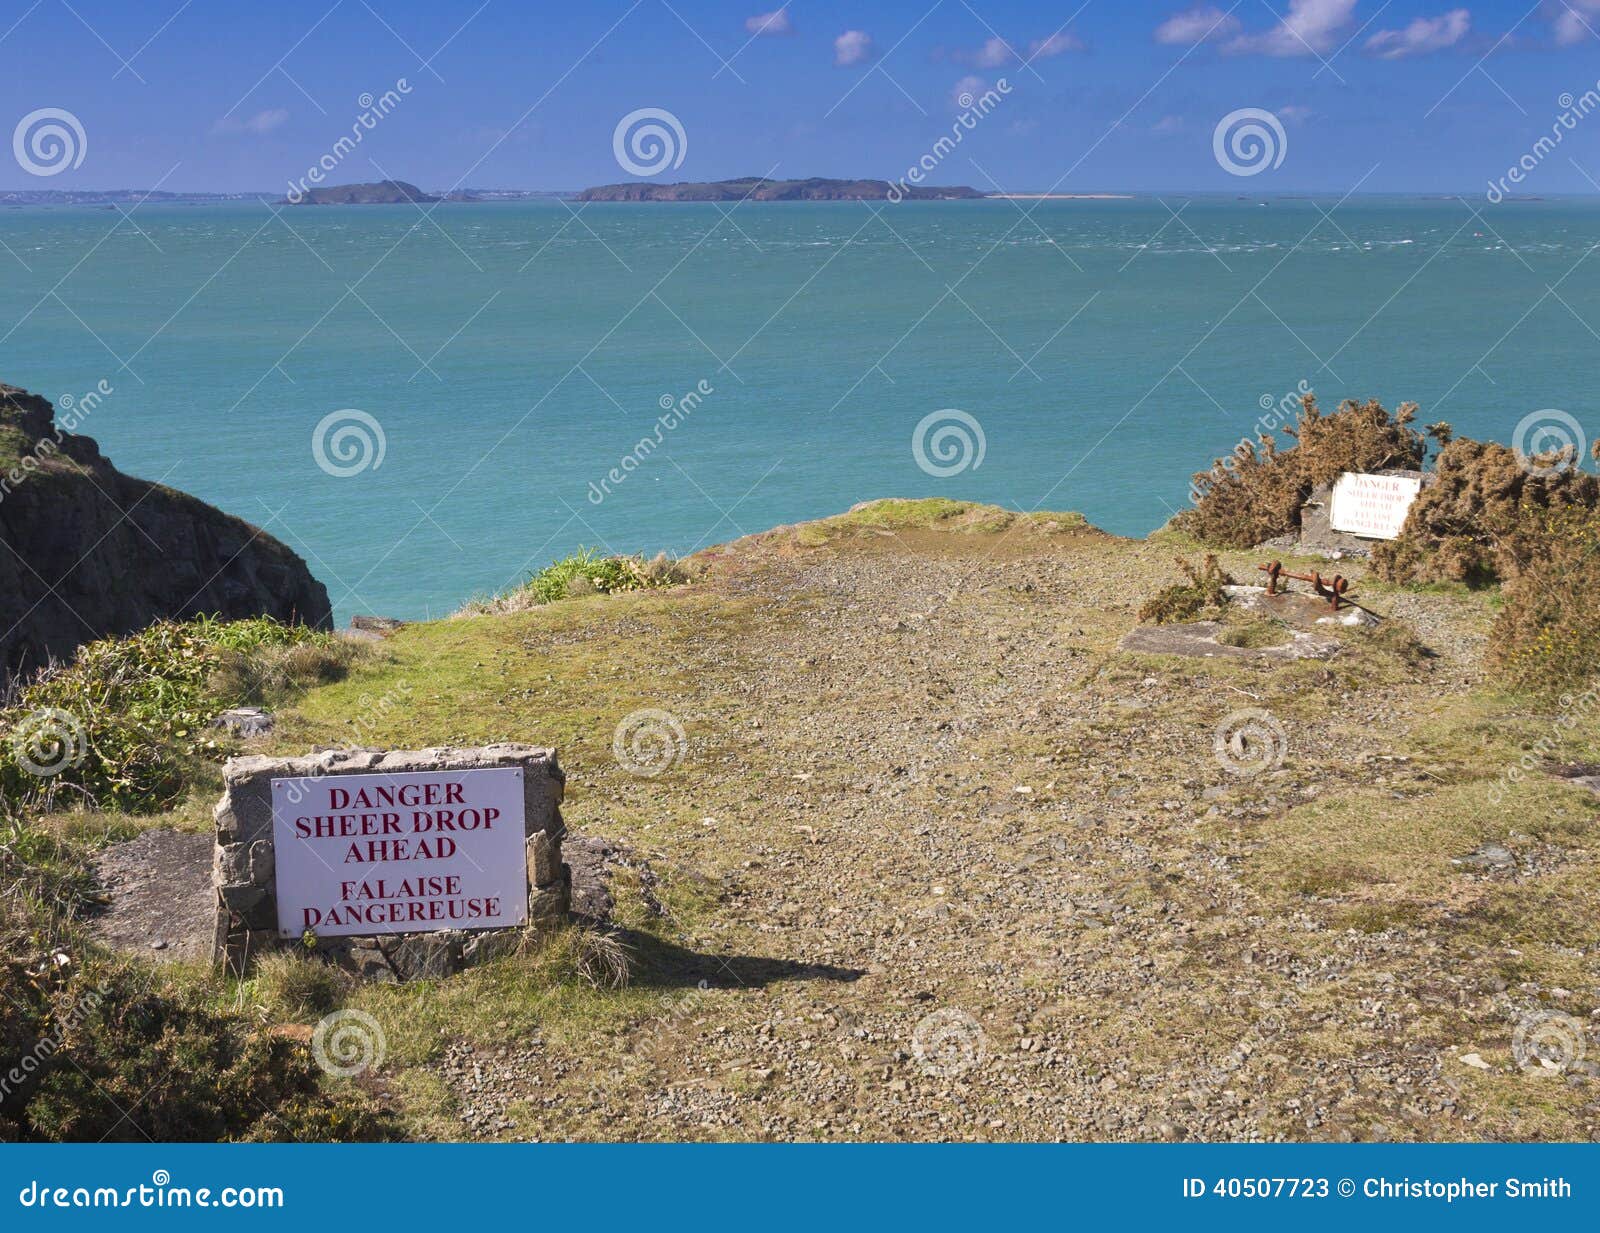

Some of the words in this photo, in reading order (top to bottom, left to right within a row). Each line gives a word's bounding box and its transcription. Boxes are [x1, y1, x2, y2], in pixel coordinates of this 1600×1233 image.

[328, 782, 466, 811] DANGER
[295, 811, 402, 840] SHEER
[413, 807, 501, 833] DROP
[344, 836, 457, 864] AHEAD
[340, 875, 462, 901] FALAISE
[303, 897, 501, 928] DANGEREUSE
